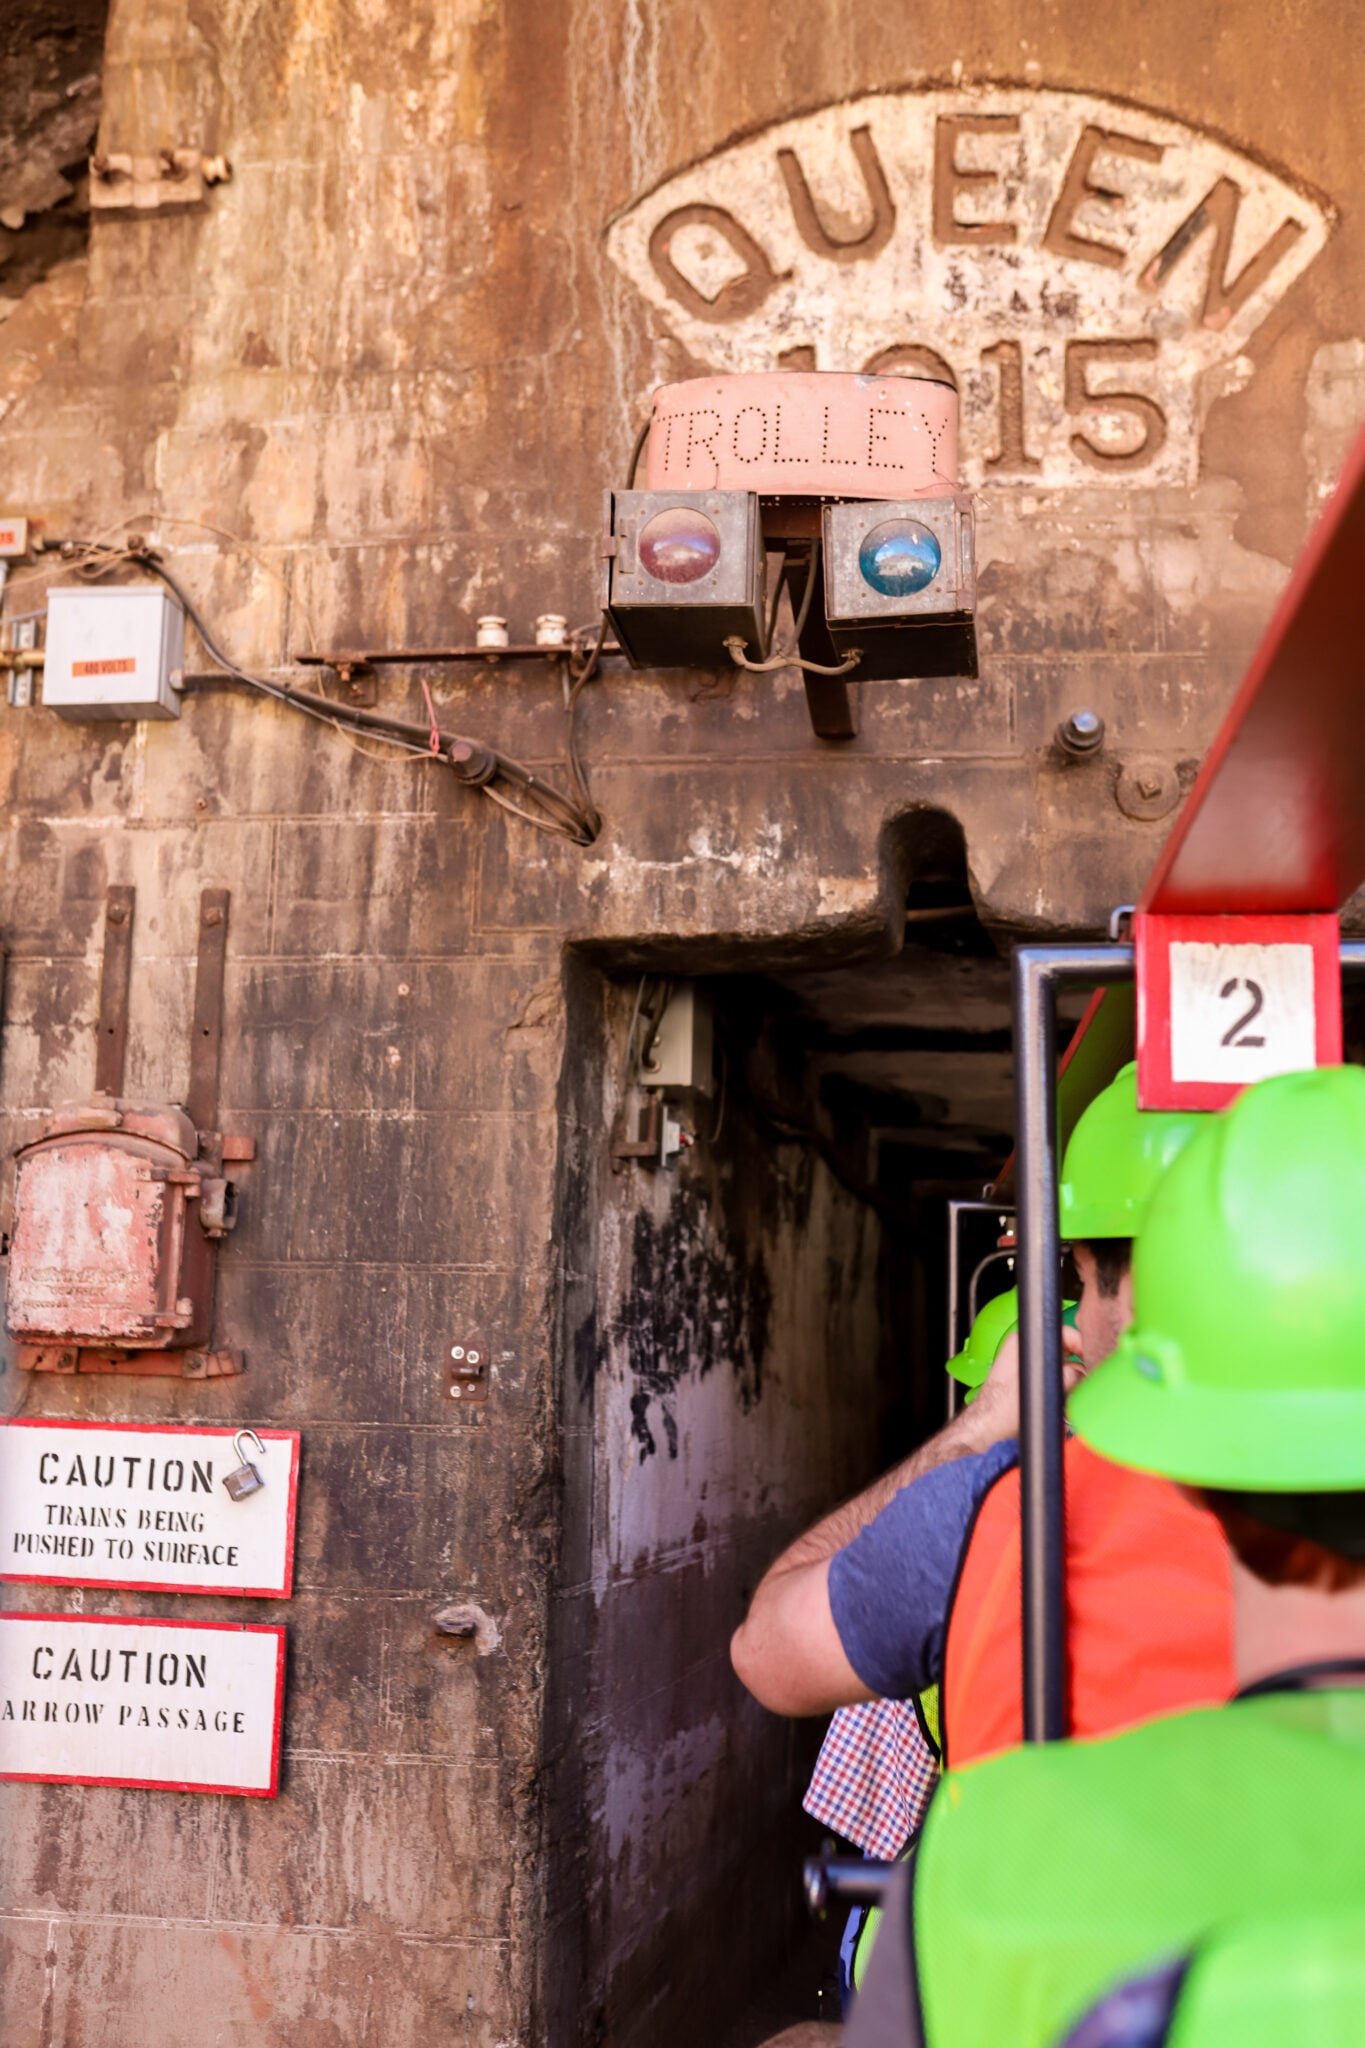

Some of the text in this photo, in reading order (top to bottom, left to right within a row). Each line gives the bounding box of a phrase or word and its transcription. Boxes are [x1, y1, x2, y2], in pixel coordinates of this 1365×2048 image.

[648, 113, 1308, 330] QUEEN
[657, 405, 948, 472] TROLLEY
[102, 659, 127, 673] VOLTS
[1220, 977, 1265, 1047] 2
[39, 1452, 213, 1493] CAUTION
[45, 1504, 205, 1533] TRAINS BEING
[13, 1533, 239, 1567] PUSHED TO SURFACE
[32, 1646, 207, 1688] CAUTION
[1, 1700, 245, 1733] ARROW PASSAGE
